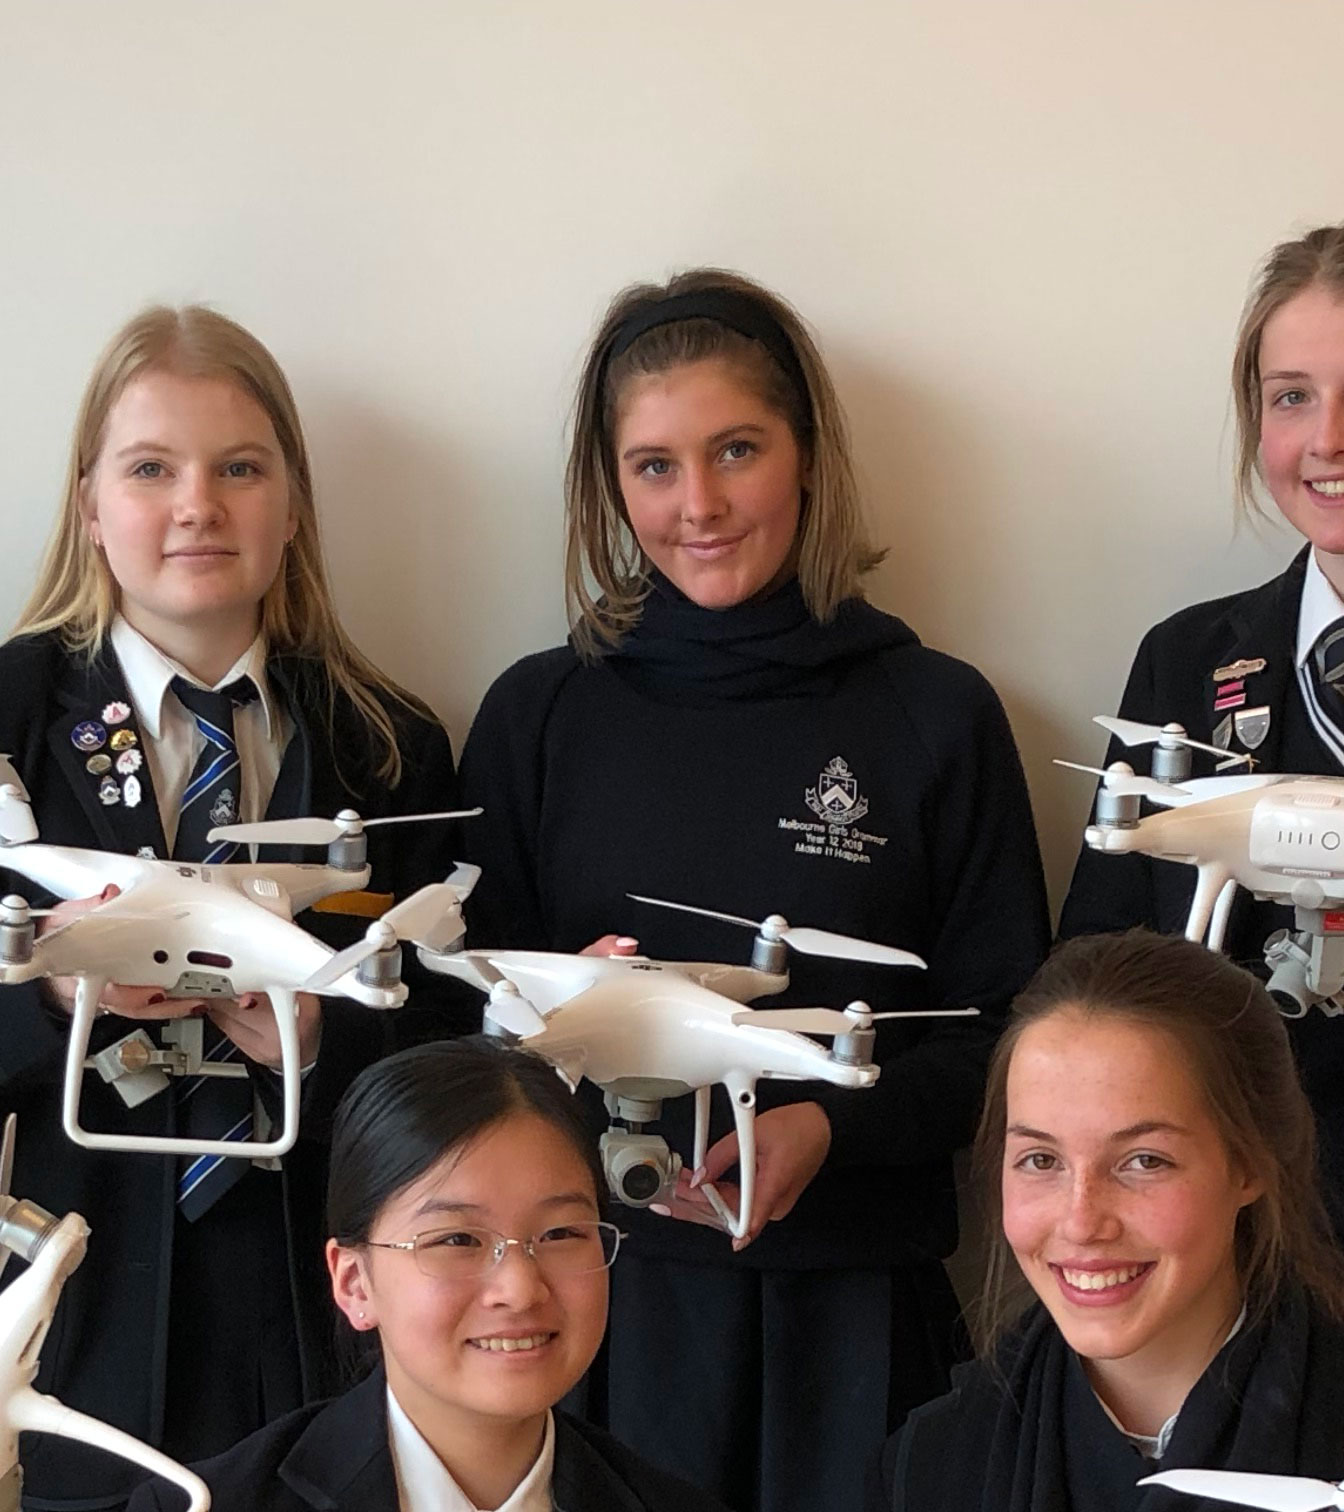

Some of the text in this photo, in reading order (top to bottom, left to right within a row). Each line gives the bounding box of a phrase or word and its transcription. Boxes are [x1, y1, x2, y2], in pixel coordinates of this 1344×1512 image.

[778, 818, 888, 845] Melbourne Girls Grammar
[806, 834, 826, 844] Year
[829, 837, 839, 846] 12
[795, 843, 822, 854] Make
[834, 850, 870, 863] Happen
